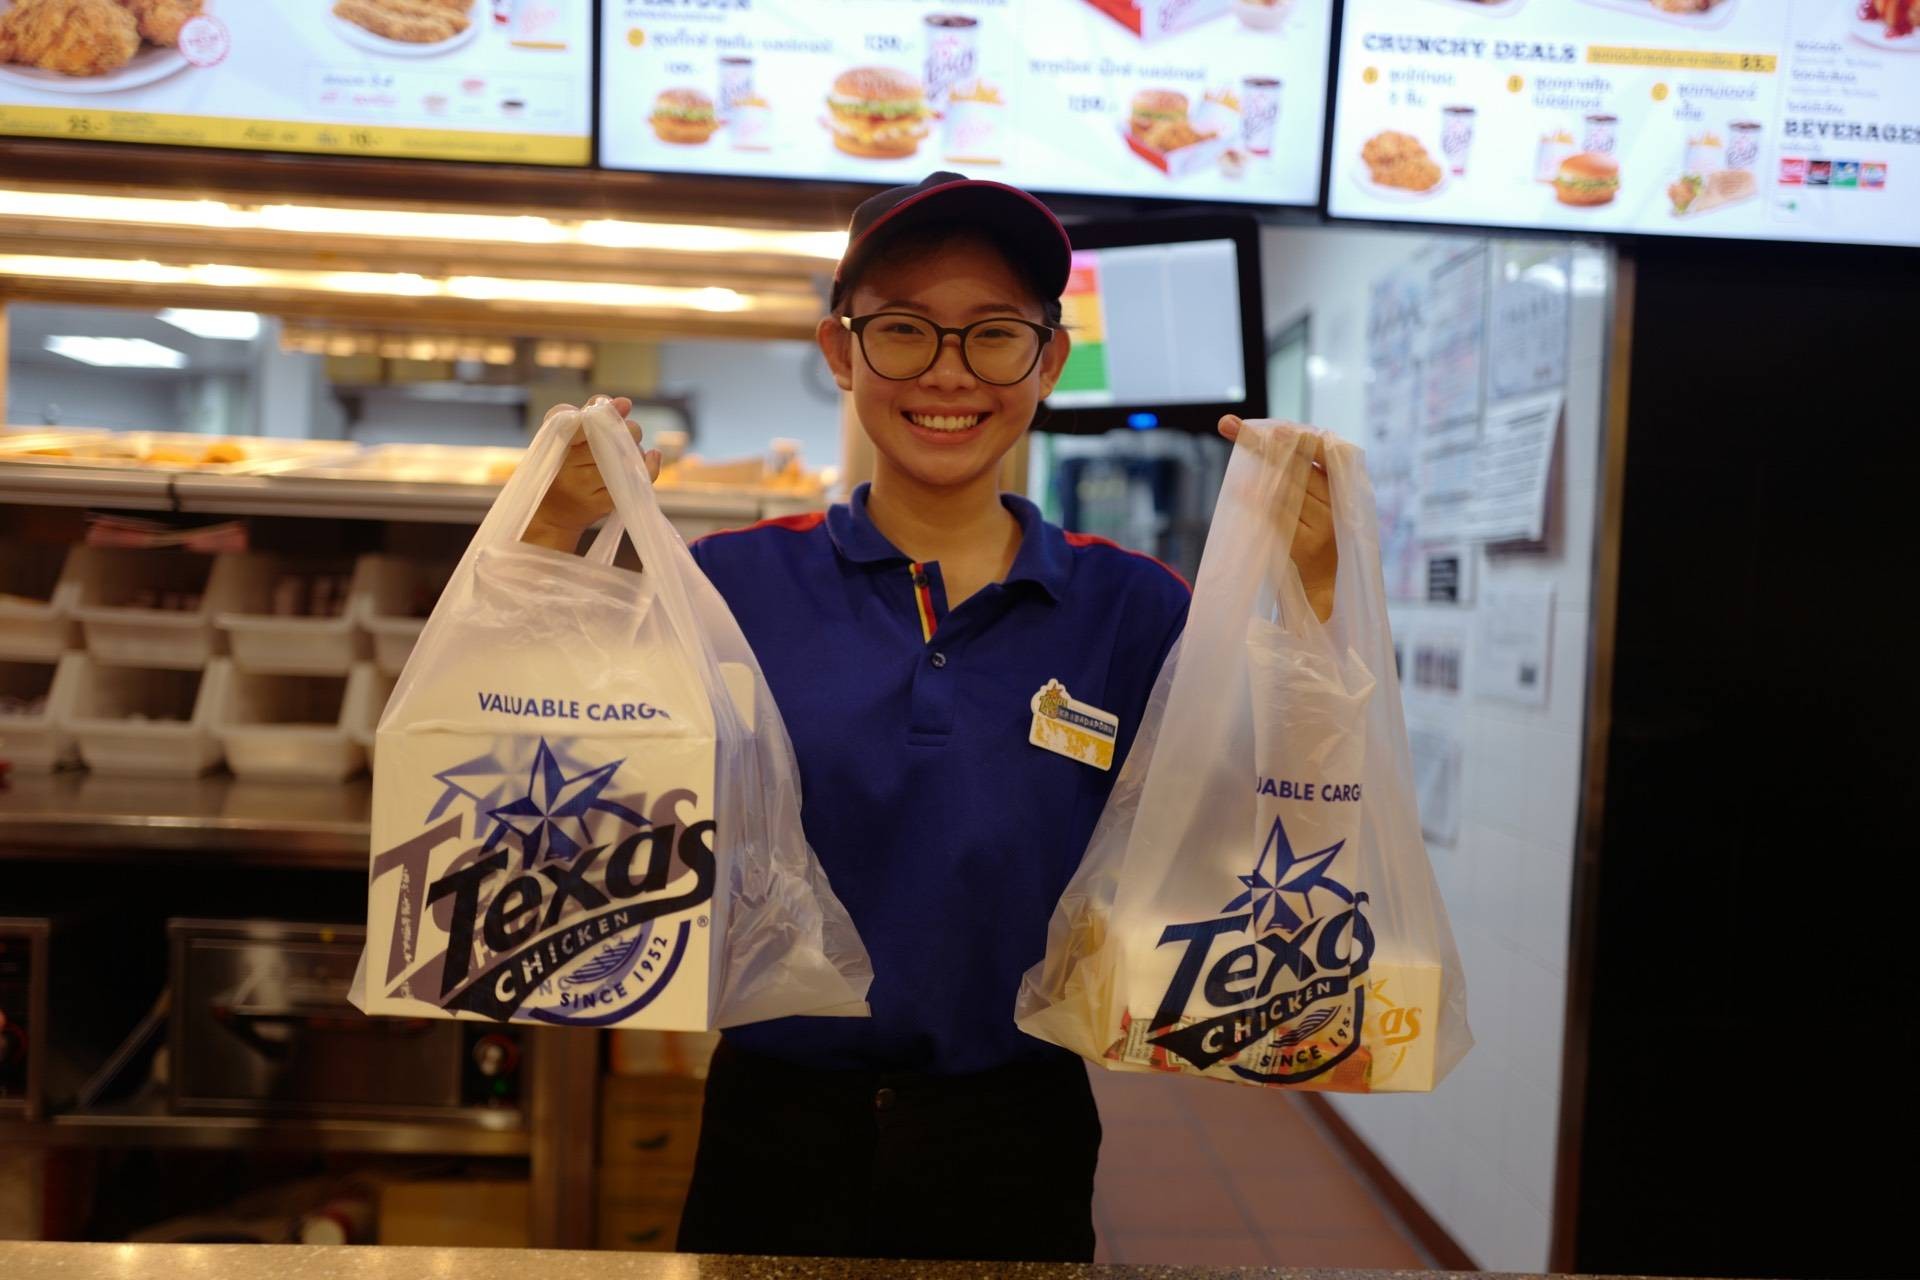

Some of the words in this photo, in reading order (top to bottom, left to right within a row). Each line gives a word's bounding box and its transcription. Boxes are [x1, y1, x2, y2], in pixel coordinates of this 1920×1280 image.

[1363, 34, 1485, 57] CRUNCHY
[1494, 40, 1577, 62] DEALS
[478, 692, 580, 719] VALUABLE
[1321, 783, 1362, 802] CARG
[425, 820, 717, 999] Texas
[494, 911, 630, 1003] CHICKEN
[559, 982, 628, 1009] SINCE
[634, 936, 668, 983] 1952
[1201, 980, 1331, 1054] CHICKEN
[1260, 1044, 1322, 1068] SINCE
[1328, 1005, 1352, 1047] 195
